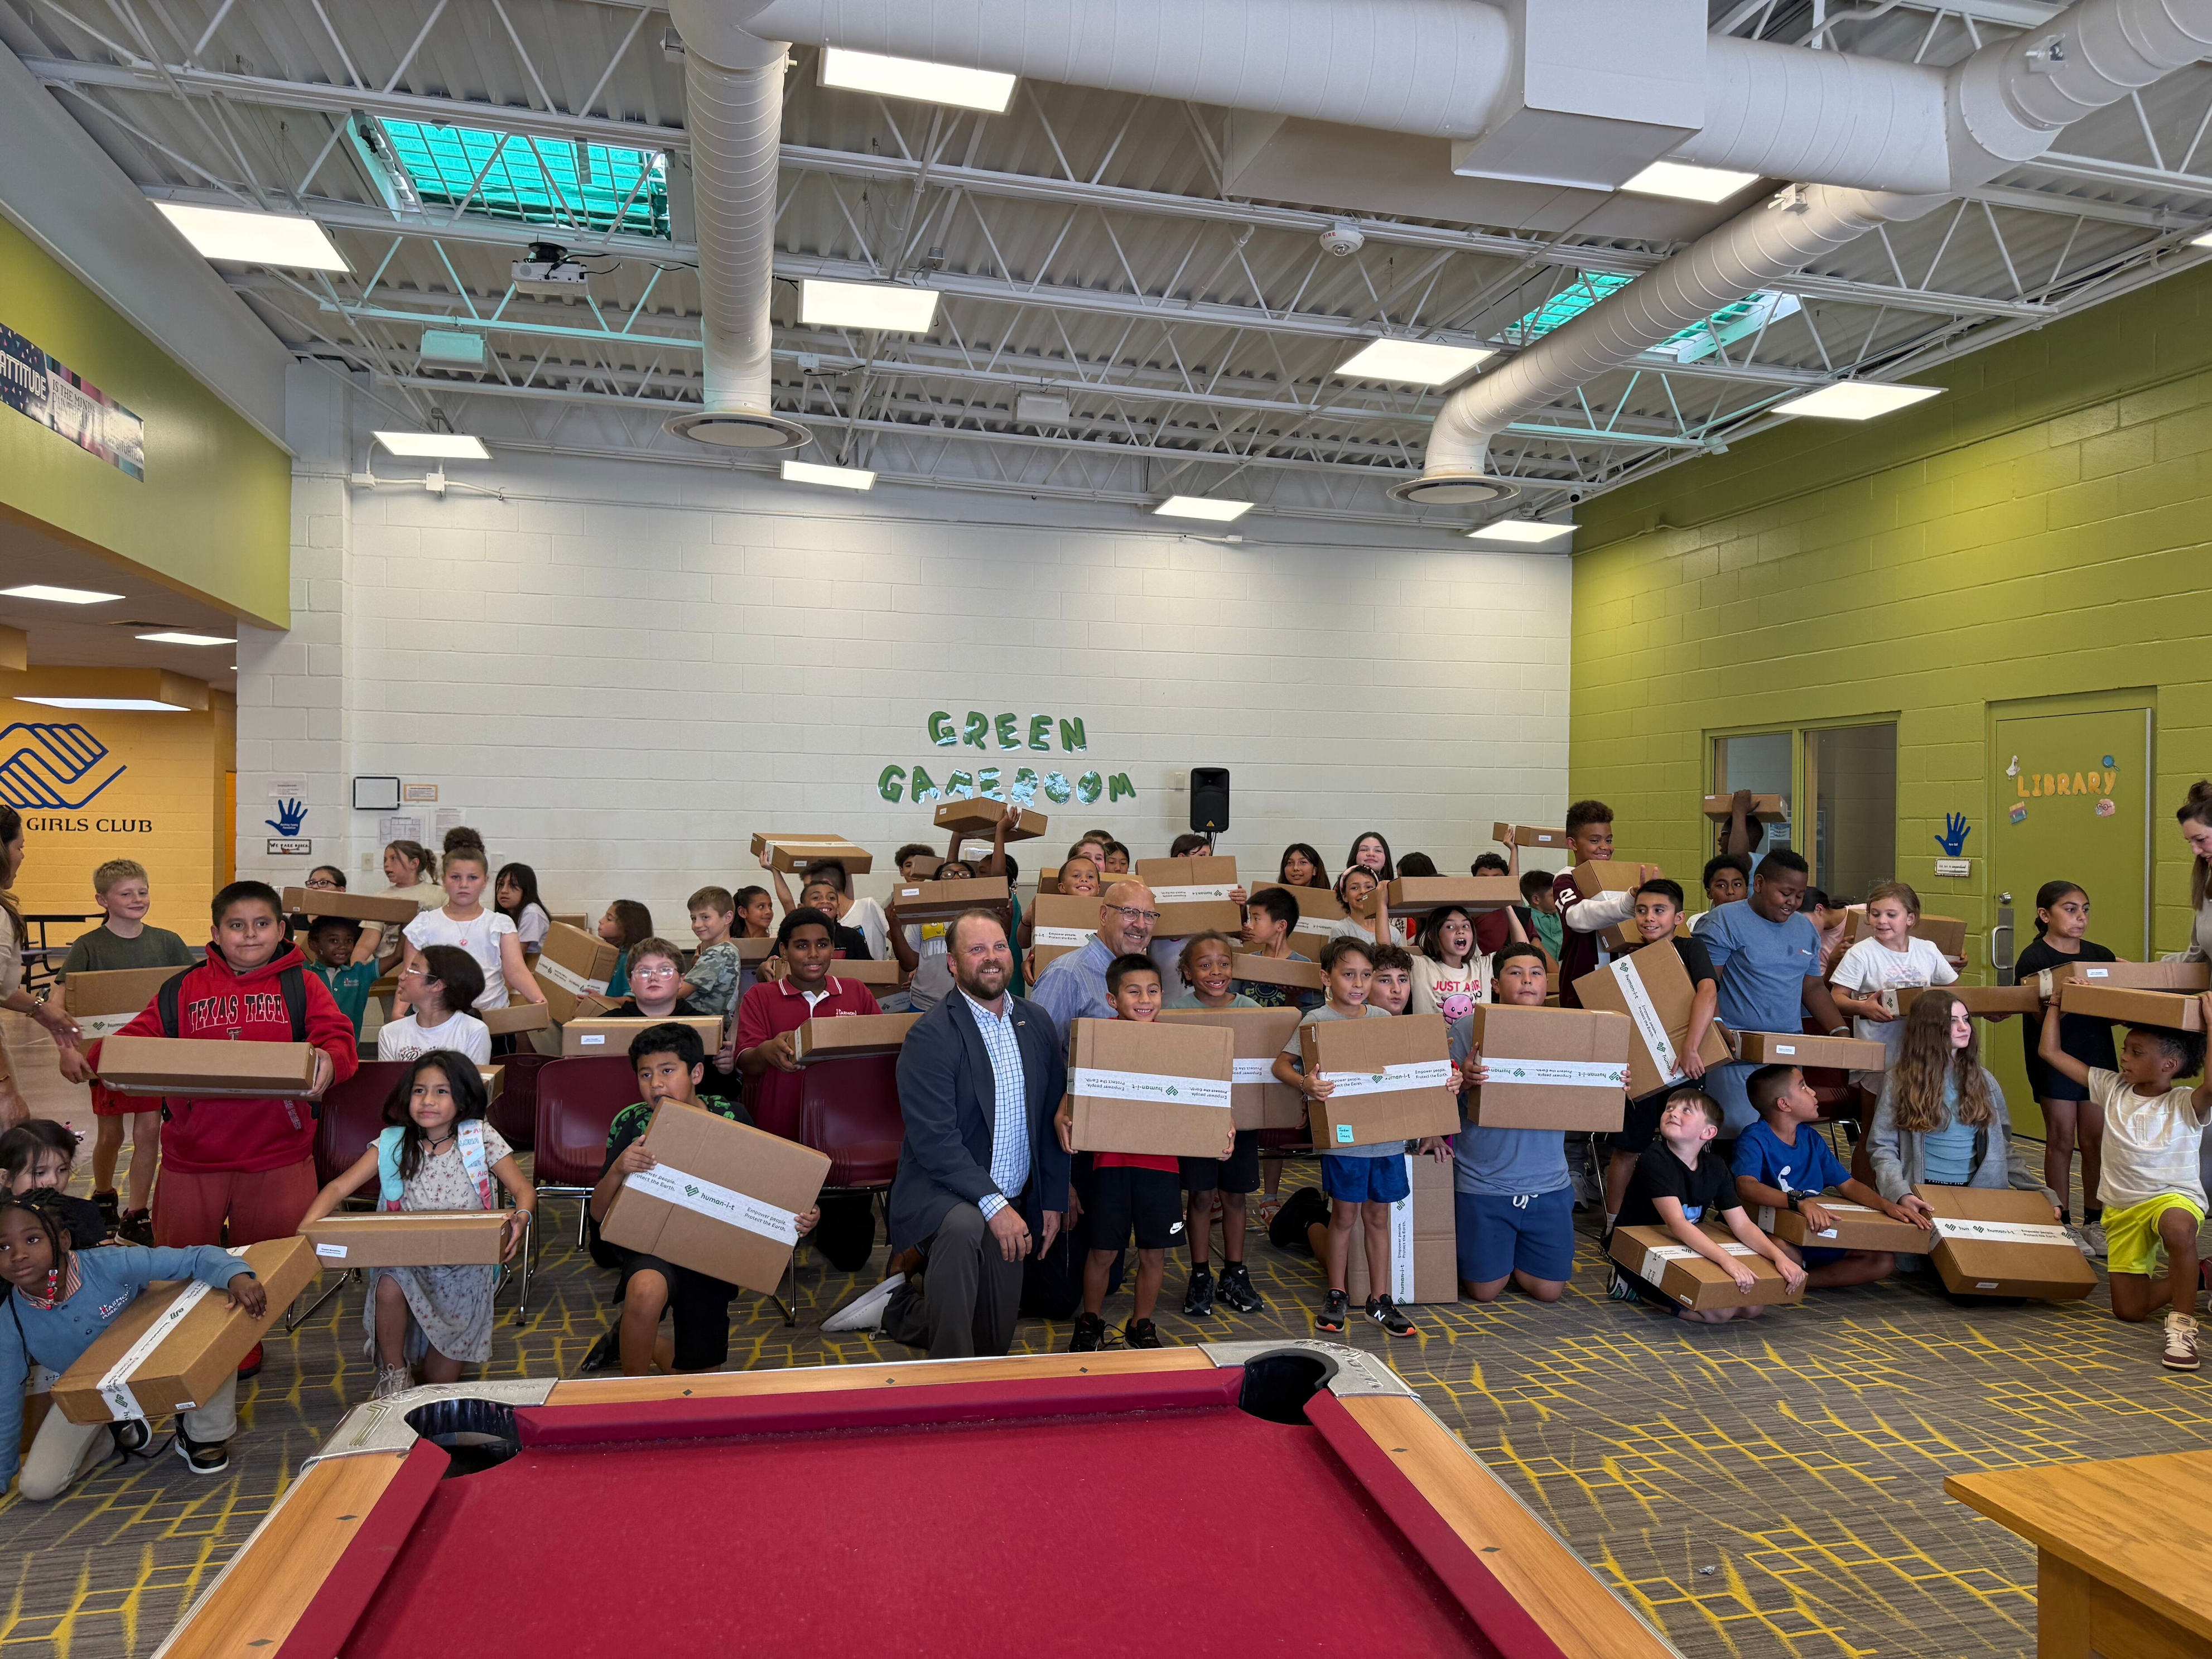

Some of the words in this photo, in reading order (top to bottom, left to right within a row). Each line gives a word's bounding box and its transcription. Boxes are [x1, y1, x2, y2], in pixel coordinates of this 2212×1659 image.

[1323, 232, 1336, 240] FIRE
[0, 350, 46, 401] ATTITUDE
[52, 379, 59, 392] IS
[60, 381, 73, 403] THE
[52, 392, 95, 431] PAINTBRU
[928, 711, 1087, 753] GREEN
[2017, 771, 2117, 798] LIBRARY
[26, 817, 89, 832] GIRLS
[96, 818, 152, 832] CLUB
[1555, 888, 1577, 914] 12
[1433, 980, 1461, 992] JUST
[1463, 982, 1470, 992] A
[1625, 974, 1638, 999] human-i-t
[188, 995, 239, 1033] TEXAS
[244, 992, 286, 1024] TECH
[1131, 1084, 1163, 1092] human-i-t
[658, 1175, 676, 1185] people.
[659, 1182, 676, 1192] Earth.
[700, 1193, 735, 1211] human-i-t
[744, 1213, 763, 1223] Protect
[772, 1223, 786, 1232] Earth.
[746, 1207, 770, 1219] Empower
[770, 1217, 787, 1226] people.
